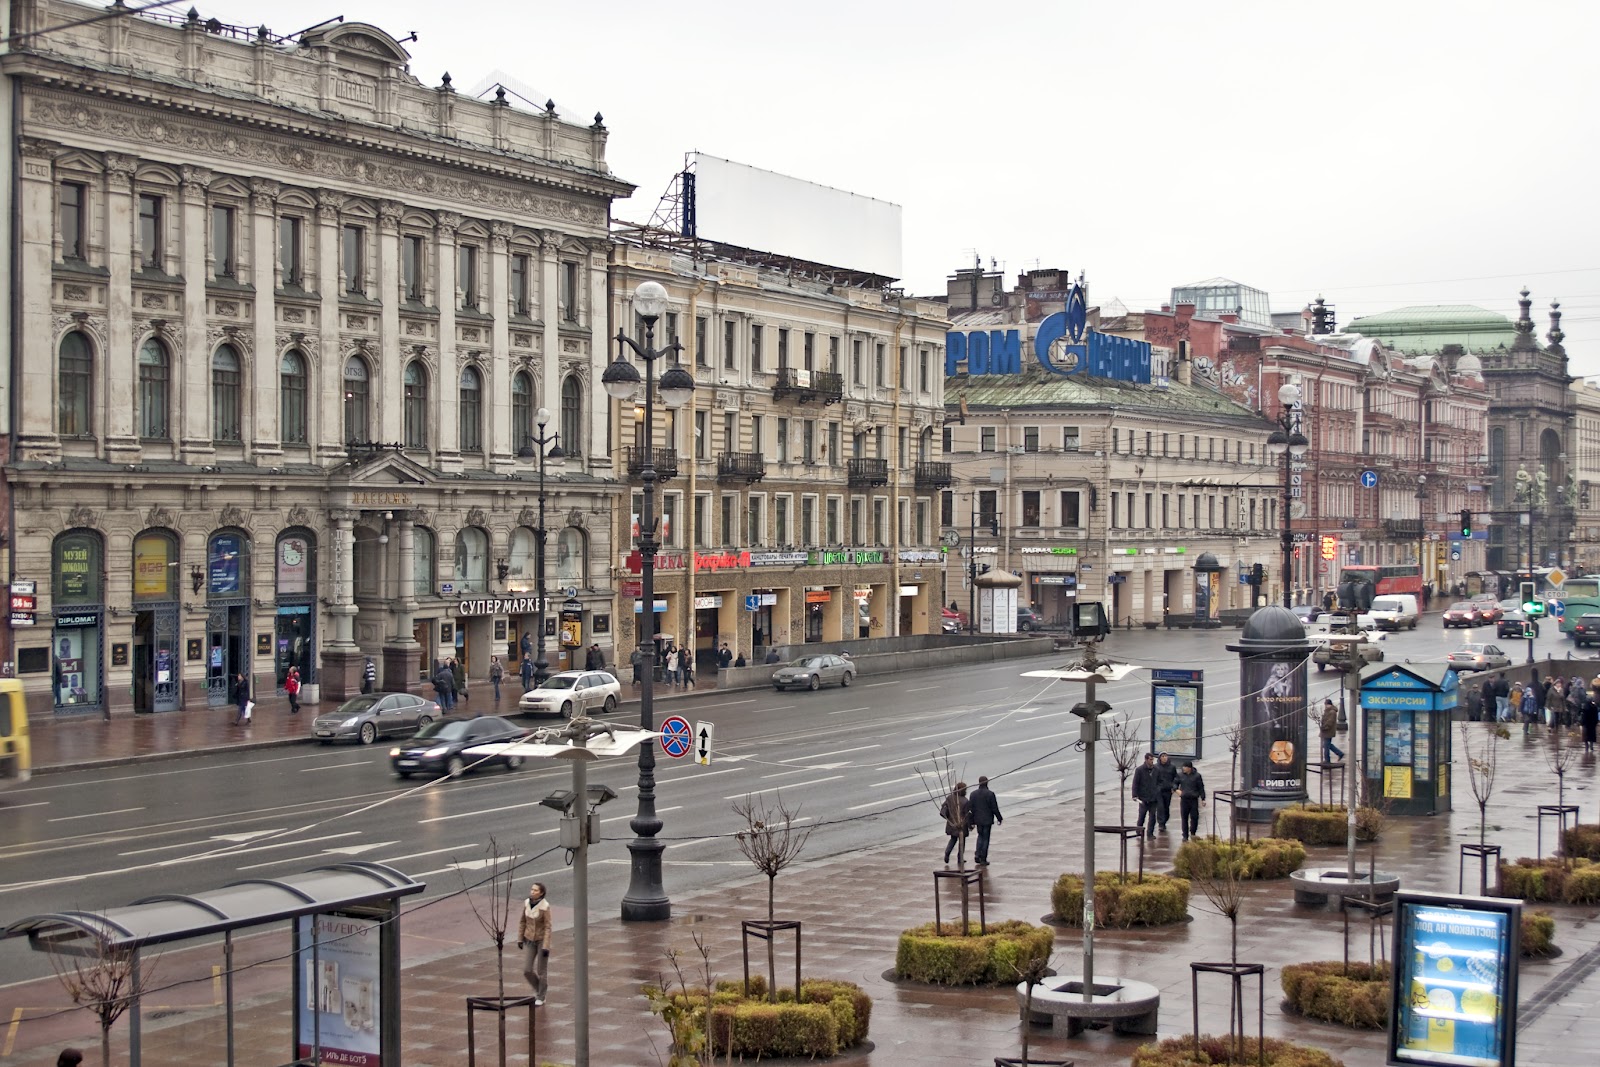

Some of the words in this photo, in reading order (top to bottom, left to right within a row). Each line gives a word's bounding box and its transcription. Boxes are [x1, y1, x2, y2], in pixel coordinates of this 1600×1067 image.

[63, 549, 88, 560] МУЗЕЙ
[823, 552, 847, 565] ЦВЕТЫ
[856, 552, 883, 566] БУКЕТЫ
[13, 598, 23, 608] 24
[58, 616, 96, 624] DIPLOMAT
[1367, 696, 1427, 705] ЭКСКУРСИИ
[326, 1051, 339, 1060] ИЛЬ
[340, 1053, 349, 1062] ДЕ
